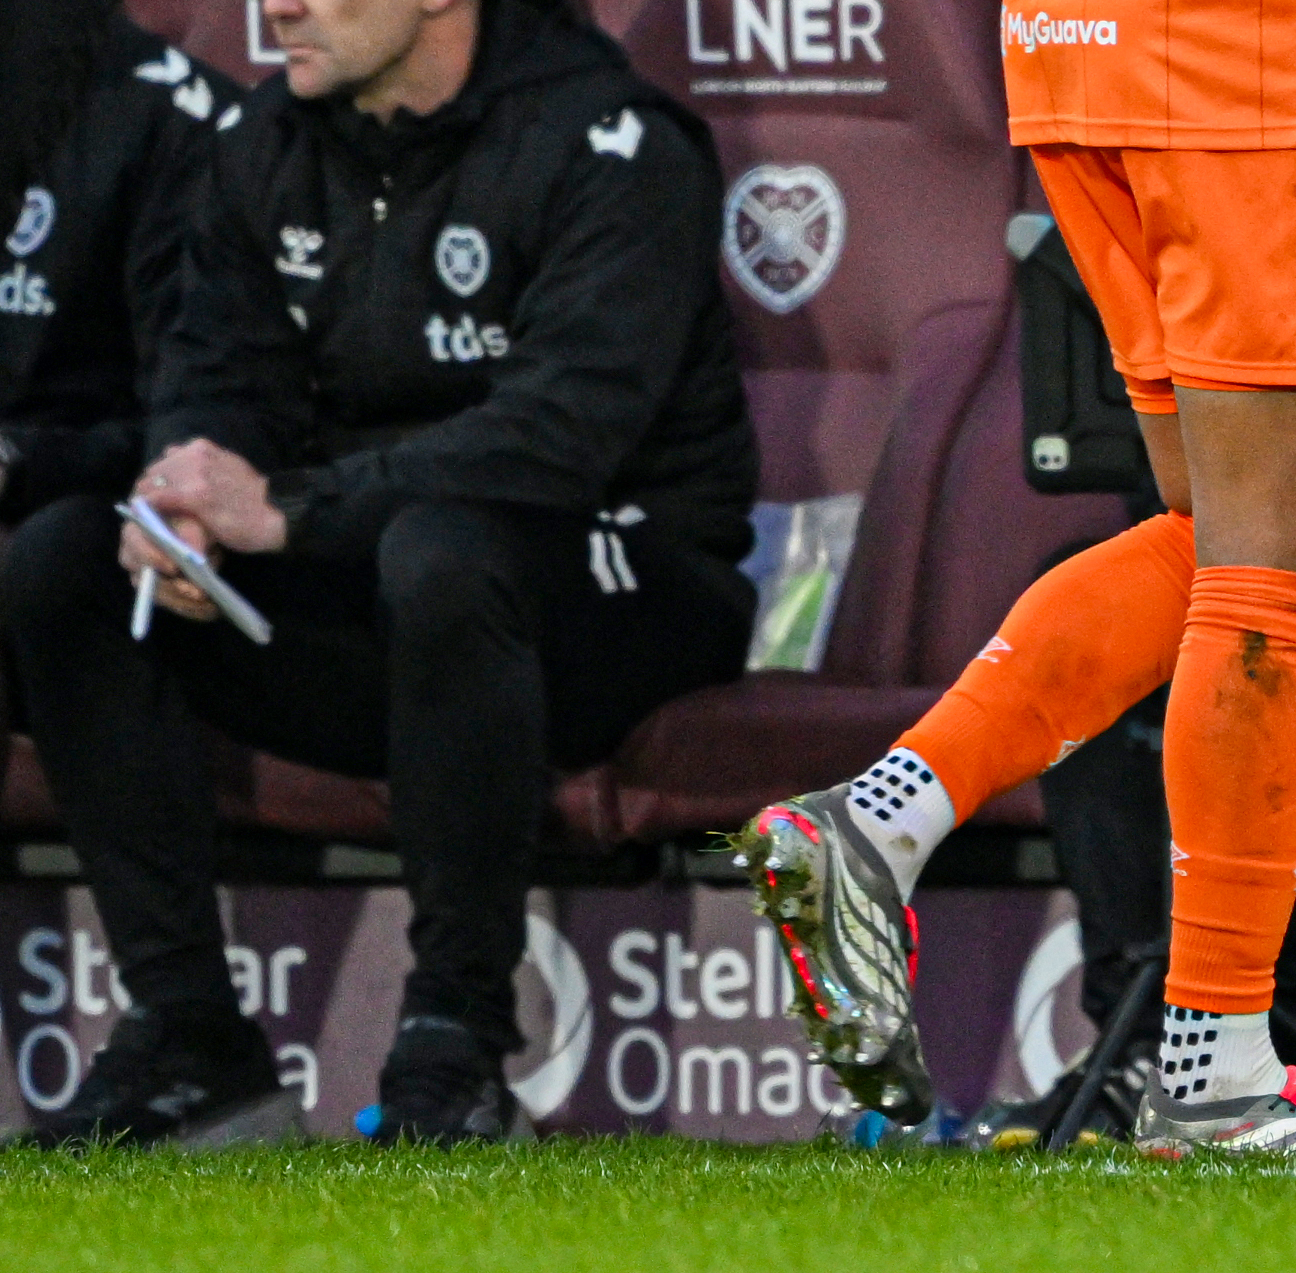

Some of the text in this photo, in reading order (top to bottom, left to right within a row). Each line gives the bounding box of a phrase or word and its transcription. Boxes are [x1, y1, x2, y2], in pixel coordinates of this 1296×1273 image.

[1007, 11, 1118, 54] MyGuava
[0, 262, 57, 316] ds.
[18, 927, 308, 1017] Star
